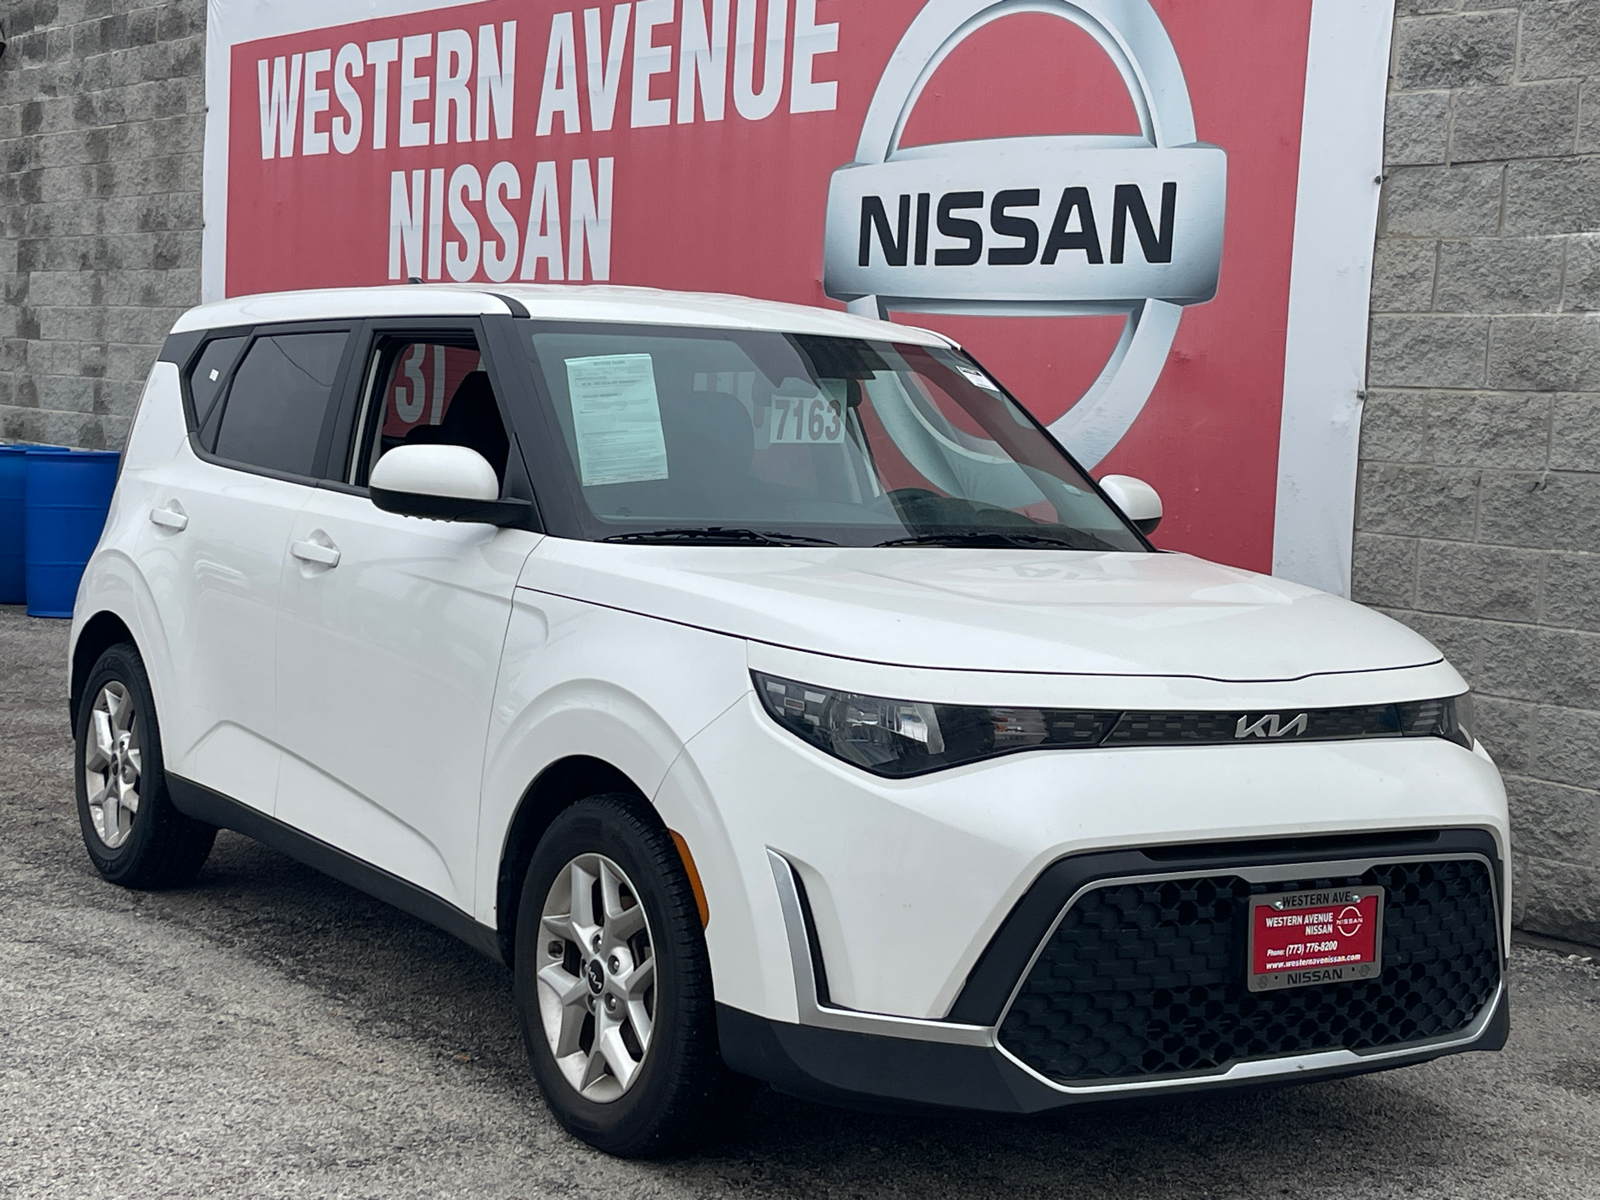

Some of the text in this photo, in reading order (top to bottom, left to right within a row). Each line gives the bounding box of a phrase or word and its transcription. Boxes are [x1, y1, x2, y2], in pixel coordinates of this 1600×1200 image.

[257, 0, 840, 160] WESTERN AVENUE
[388, 157, 614, 282] NISSAN
[858, 181, 1177, 266] NISSAN
[774, 398, 842, 441] 7163
[1234, 713, 1308, 738] KIA
[1282, 891, 1351, 908] WESTERN AVE
[1266, 913, 1333, 927] WESTERN AVENUE
[1336, 917, 1363, 925] NISSAN
[1305, 924, 1333, 936] NISSAN
[1267, 940, 1338, 958] Phone: (773) 776-8200
[1266, 954, 1361, 969] www.westernavenissan.com
[1287, 968, 1343, 985] NISSAN
